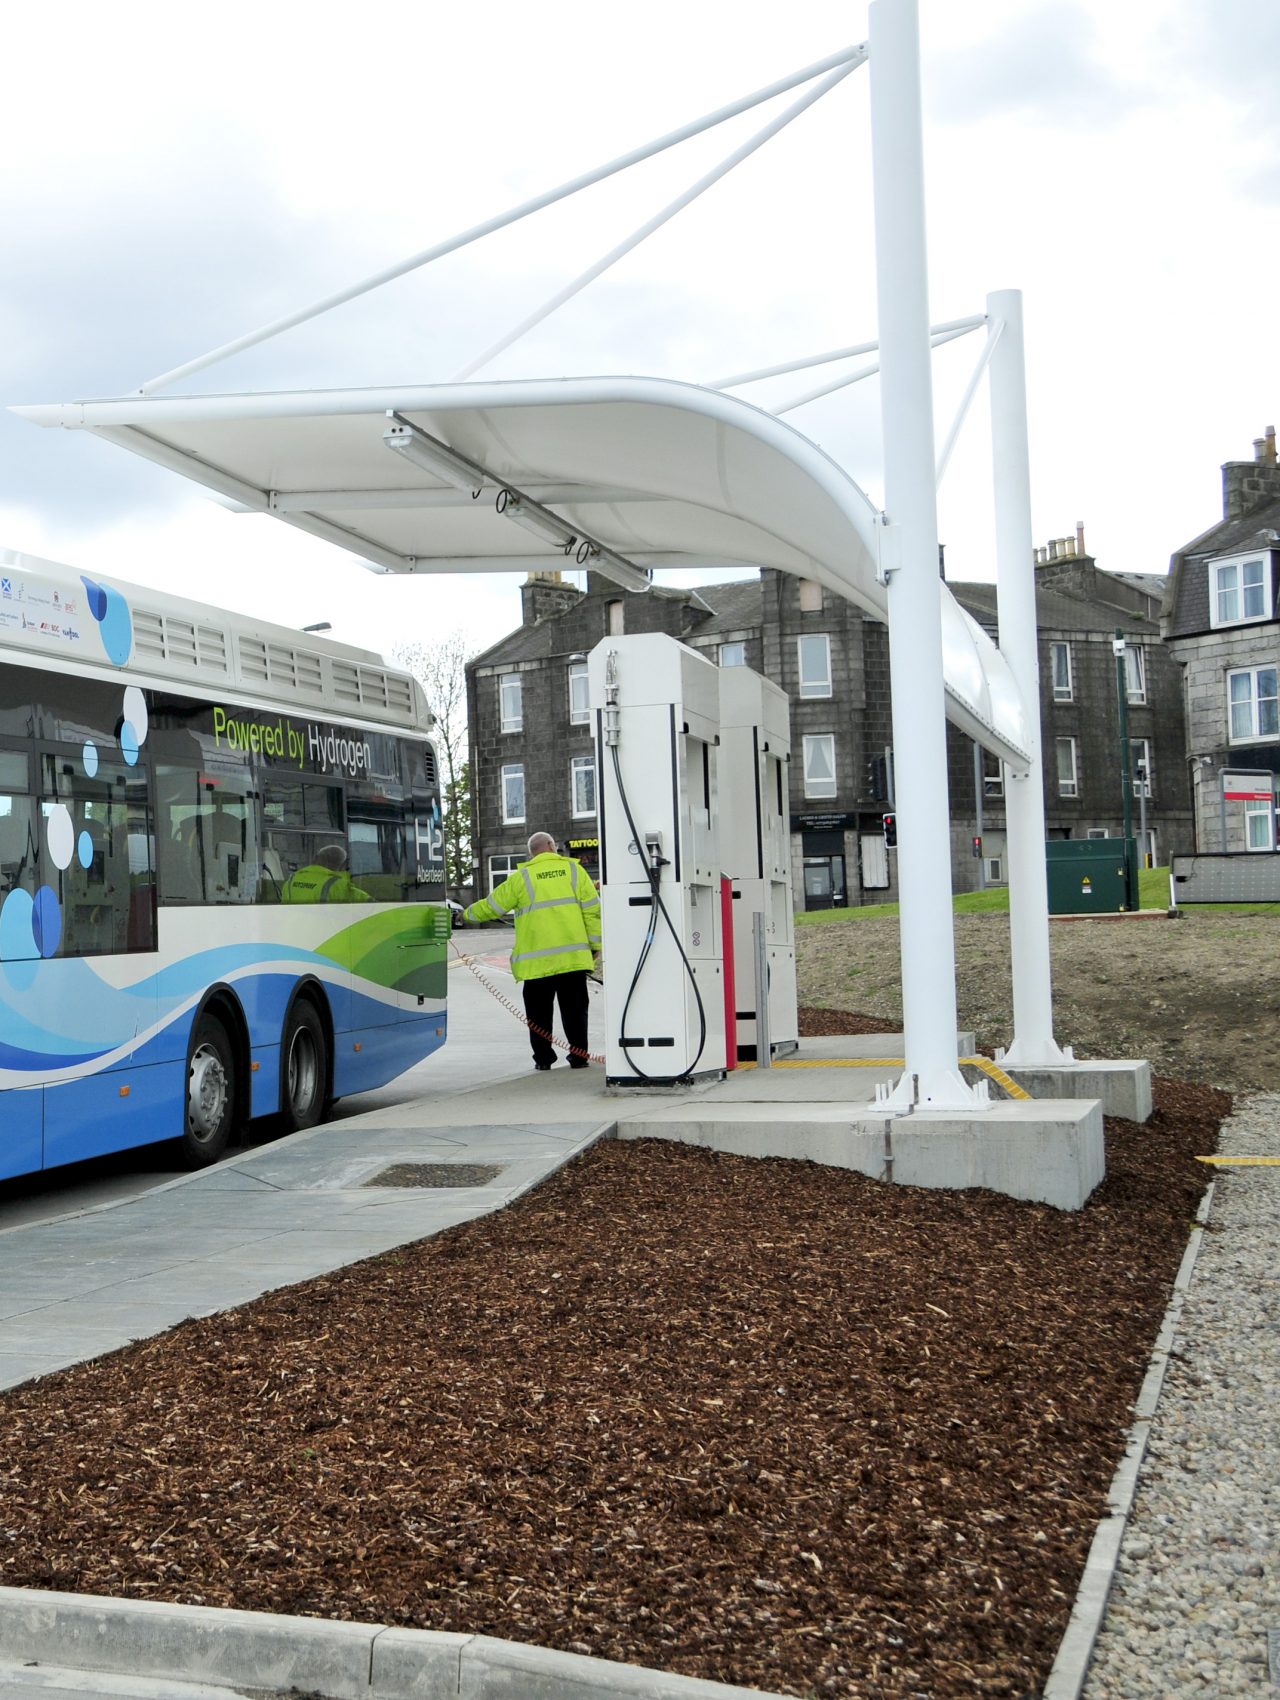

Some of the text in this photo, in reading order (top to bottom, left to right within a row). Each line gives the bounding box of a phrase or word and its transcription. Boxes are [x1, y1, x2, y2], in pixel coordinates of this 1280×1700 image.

[213, 706, 372, 777] Powered by Hydrogen
[569, 839, 599, 848] TATTOO
[417, 865, 445, 883] Aberdeen
[536, 869, 567, 880] INSPECTOR
